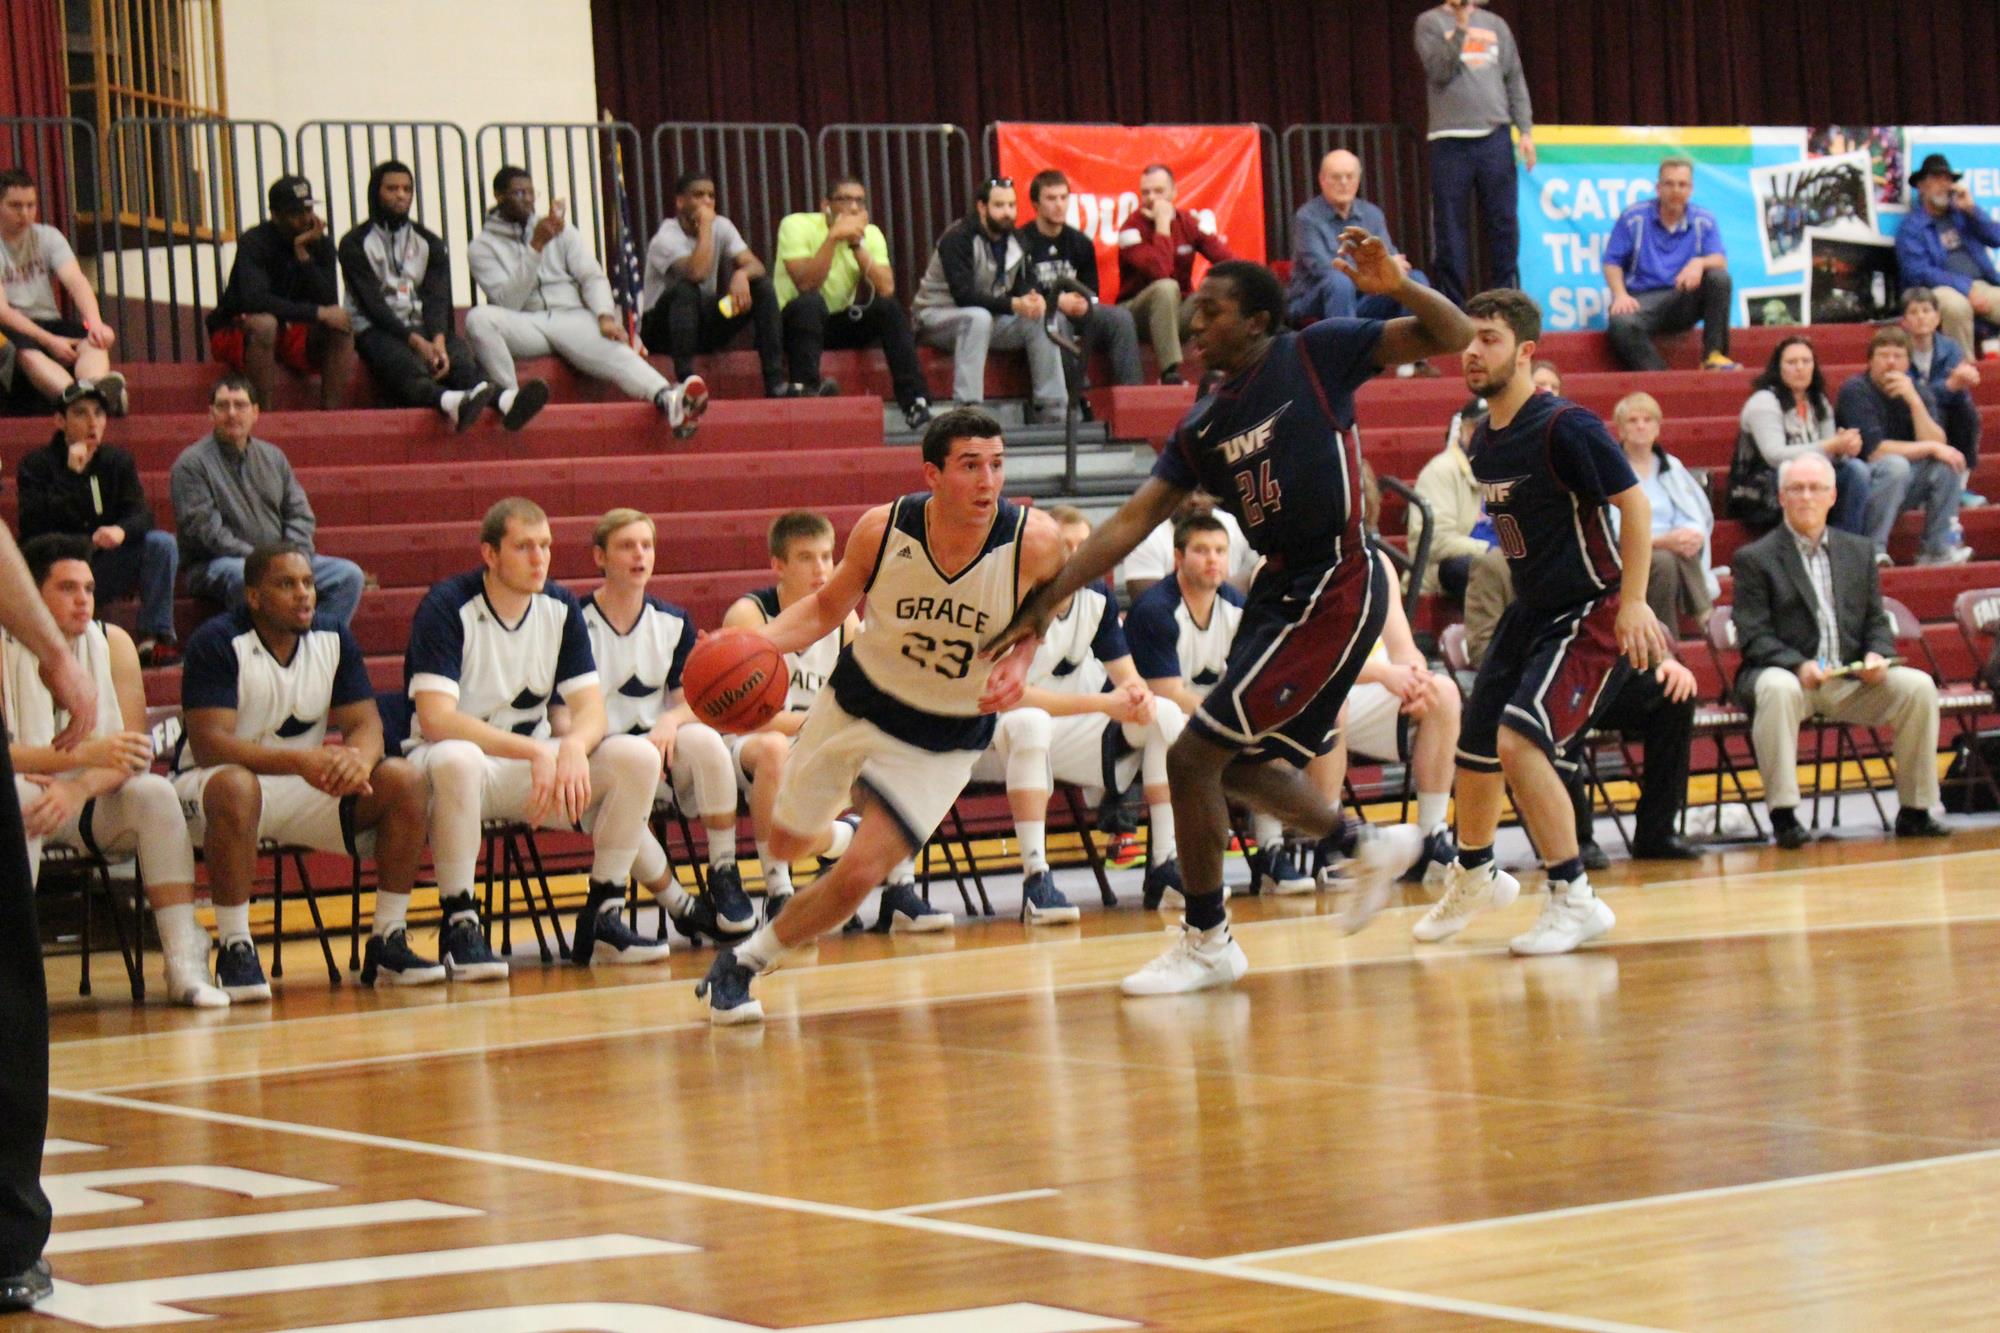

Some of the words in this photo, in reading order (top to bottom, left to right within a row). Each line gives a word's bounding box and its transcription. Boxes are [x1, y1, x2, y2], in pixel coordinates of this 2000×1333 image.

[1540, 178, 1652, 221] CATC
[1544, 232, 1606, 275] TH
[1234, 458, 1282, 528] 24
[896, 597, 991, 634] GRACE
[901, 631, 975, 679] 23
[703, 669, 765, 718] Wilson
